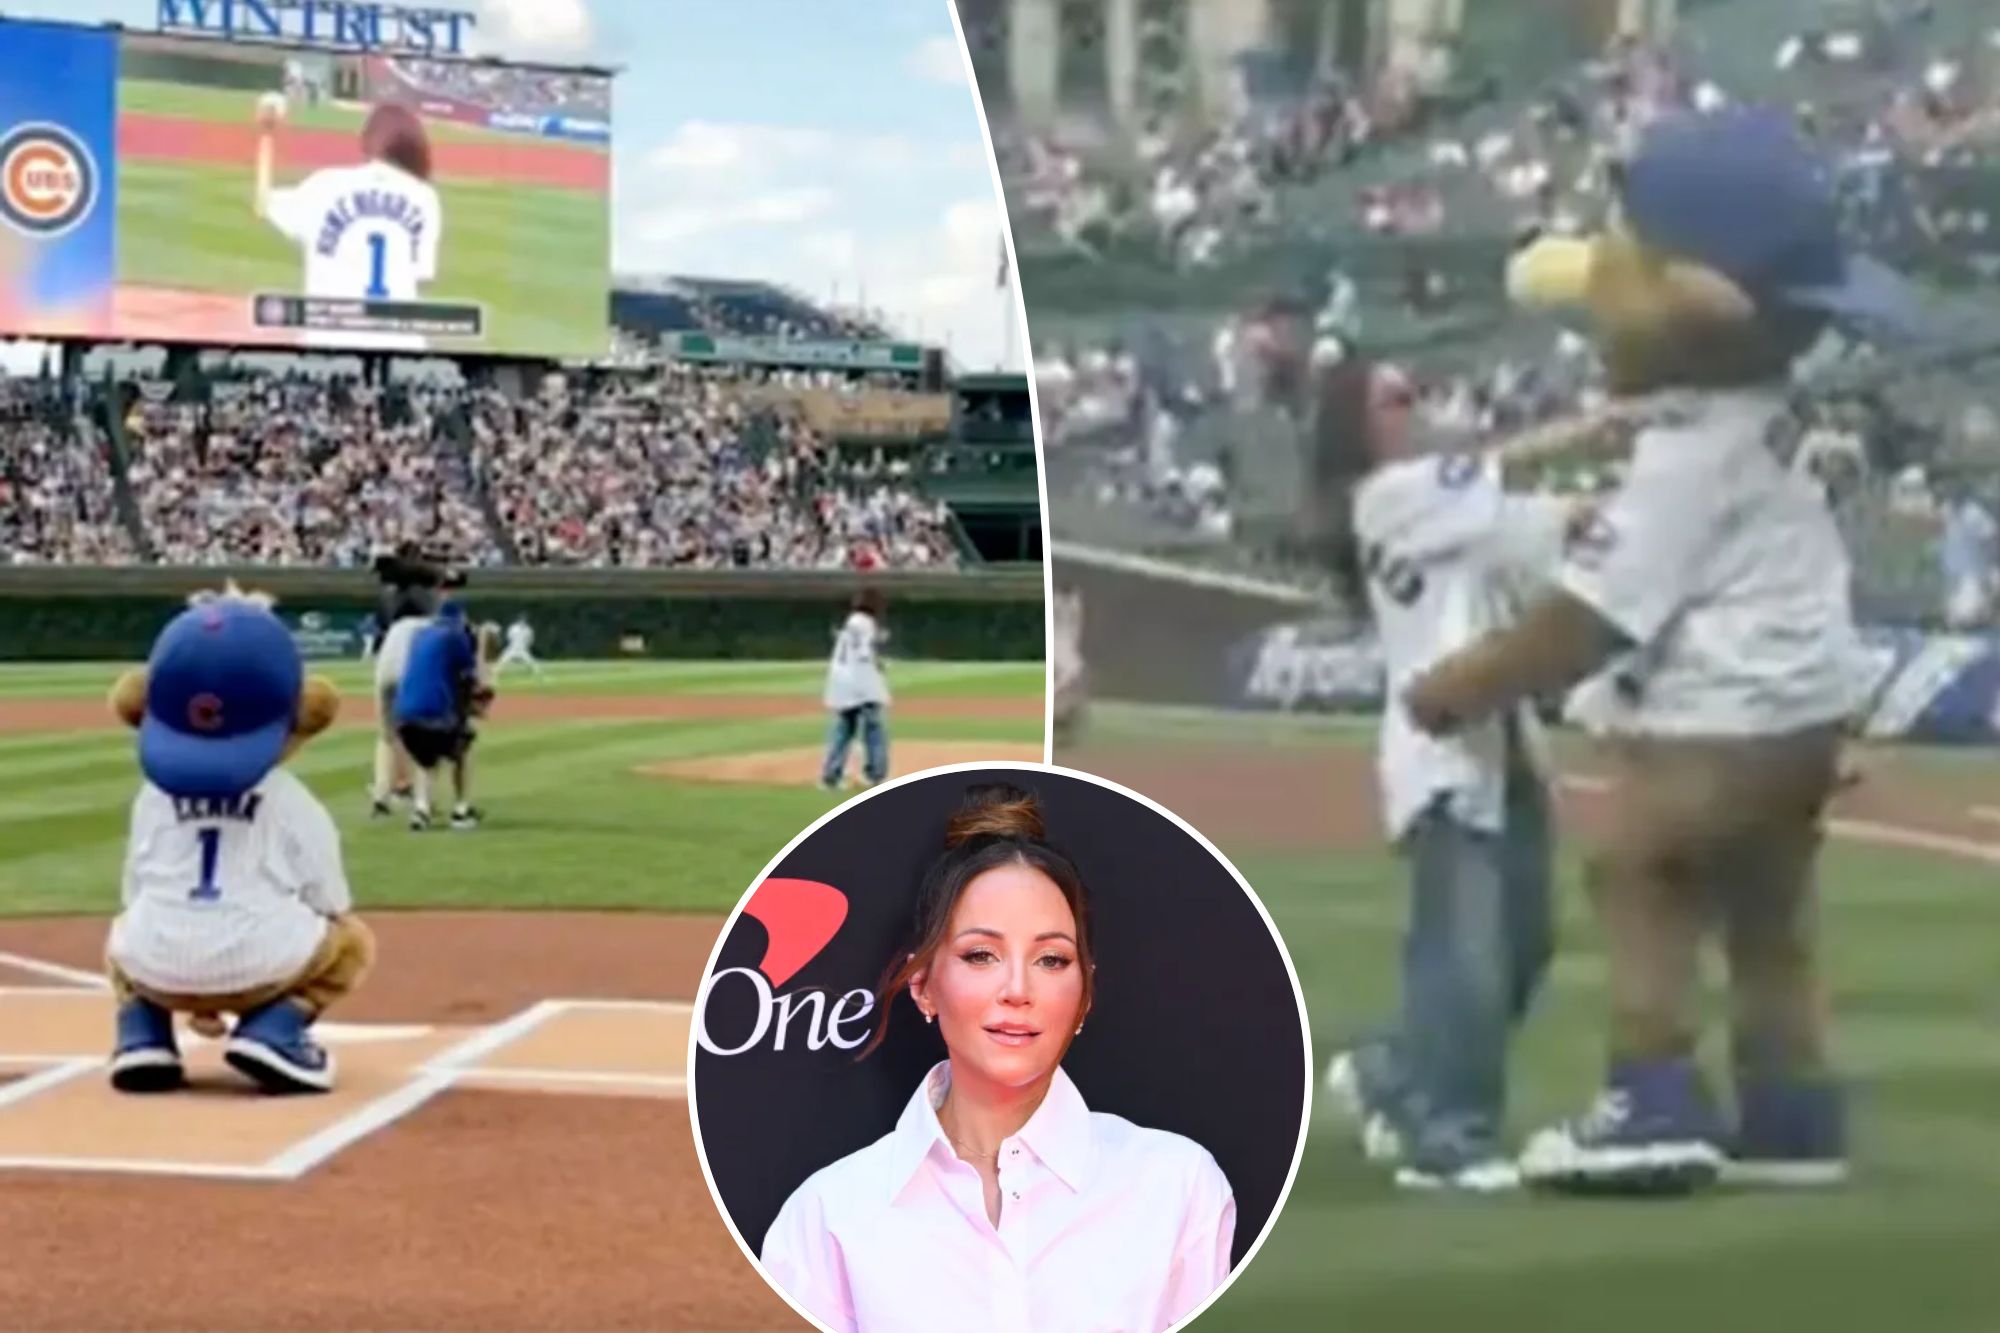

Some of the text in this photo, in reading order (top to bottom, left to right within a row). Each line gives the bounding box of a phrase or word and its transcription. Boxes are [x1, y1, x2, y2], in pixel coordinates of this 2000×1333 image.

[158, 0, 476, 56] WINTRUST
[365, 231, 390, 299] 1
[187, 693, 224, 730] C
[189, 827, 221, 899] 1
[697, 967, 874, 1055] One
